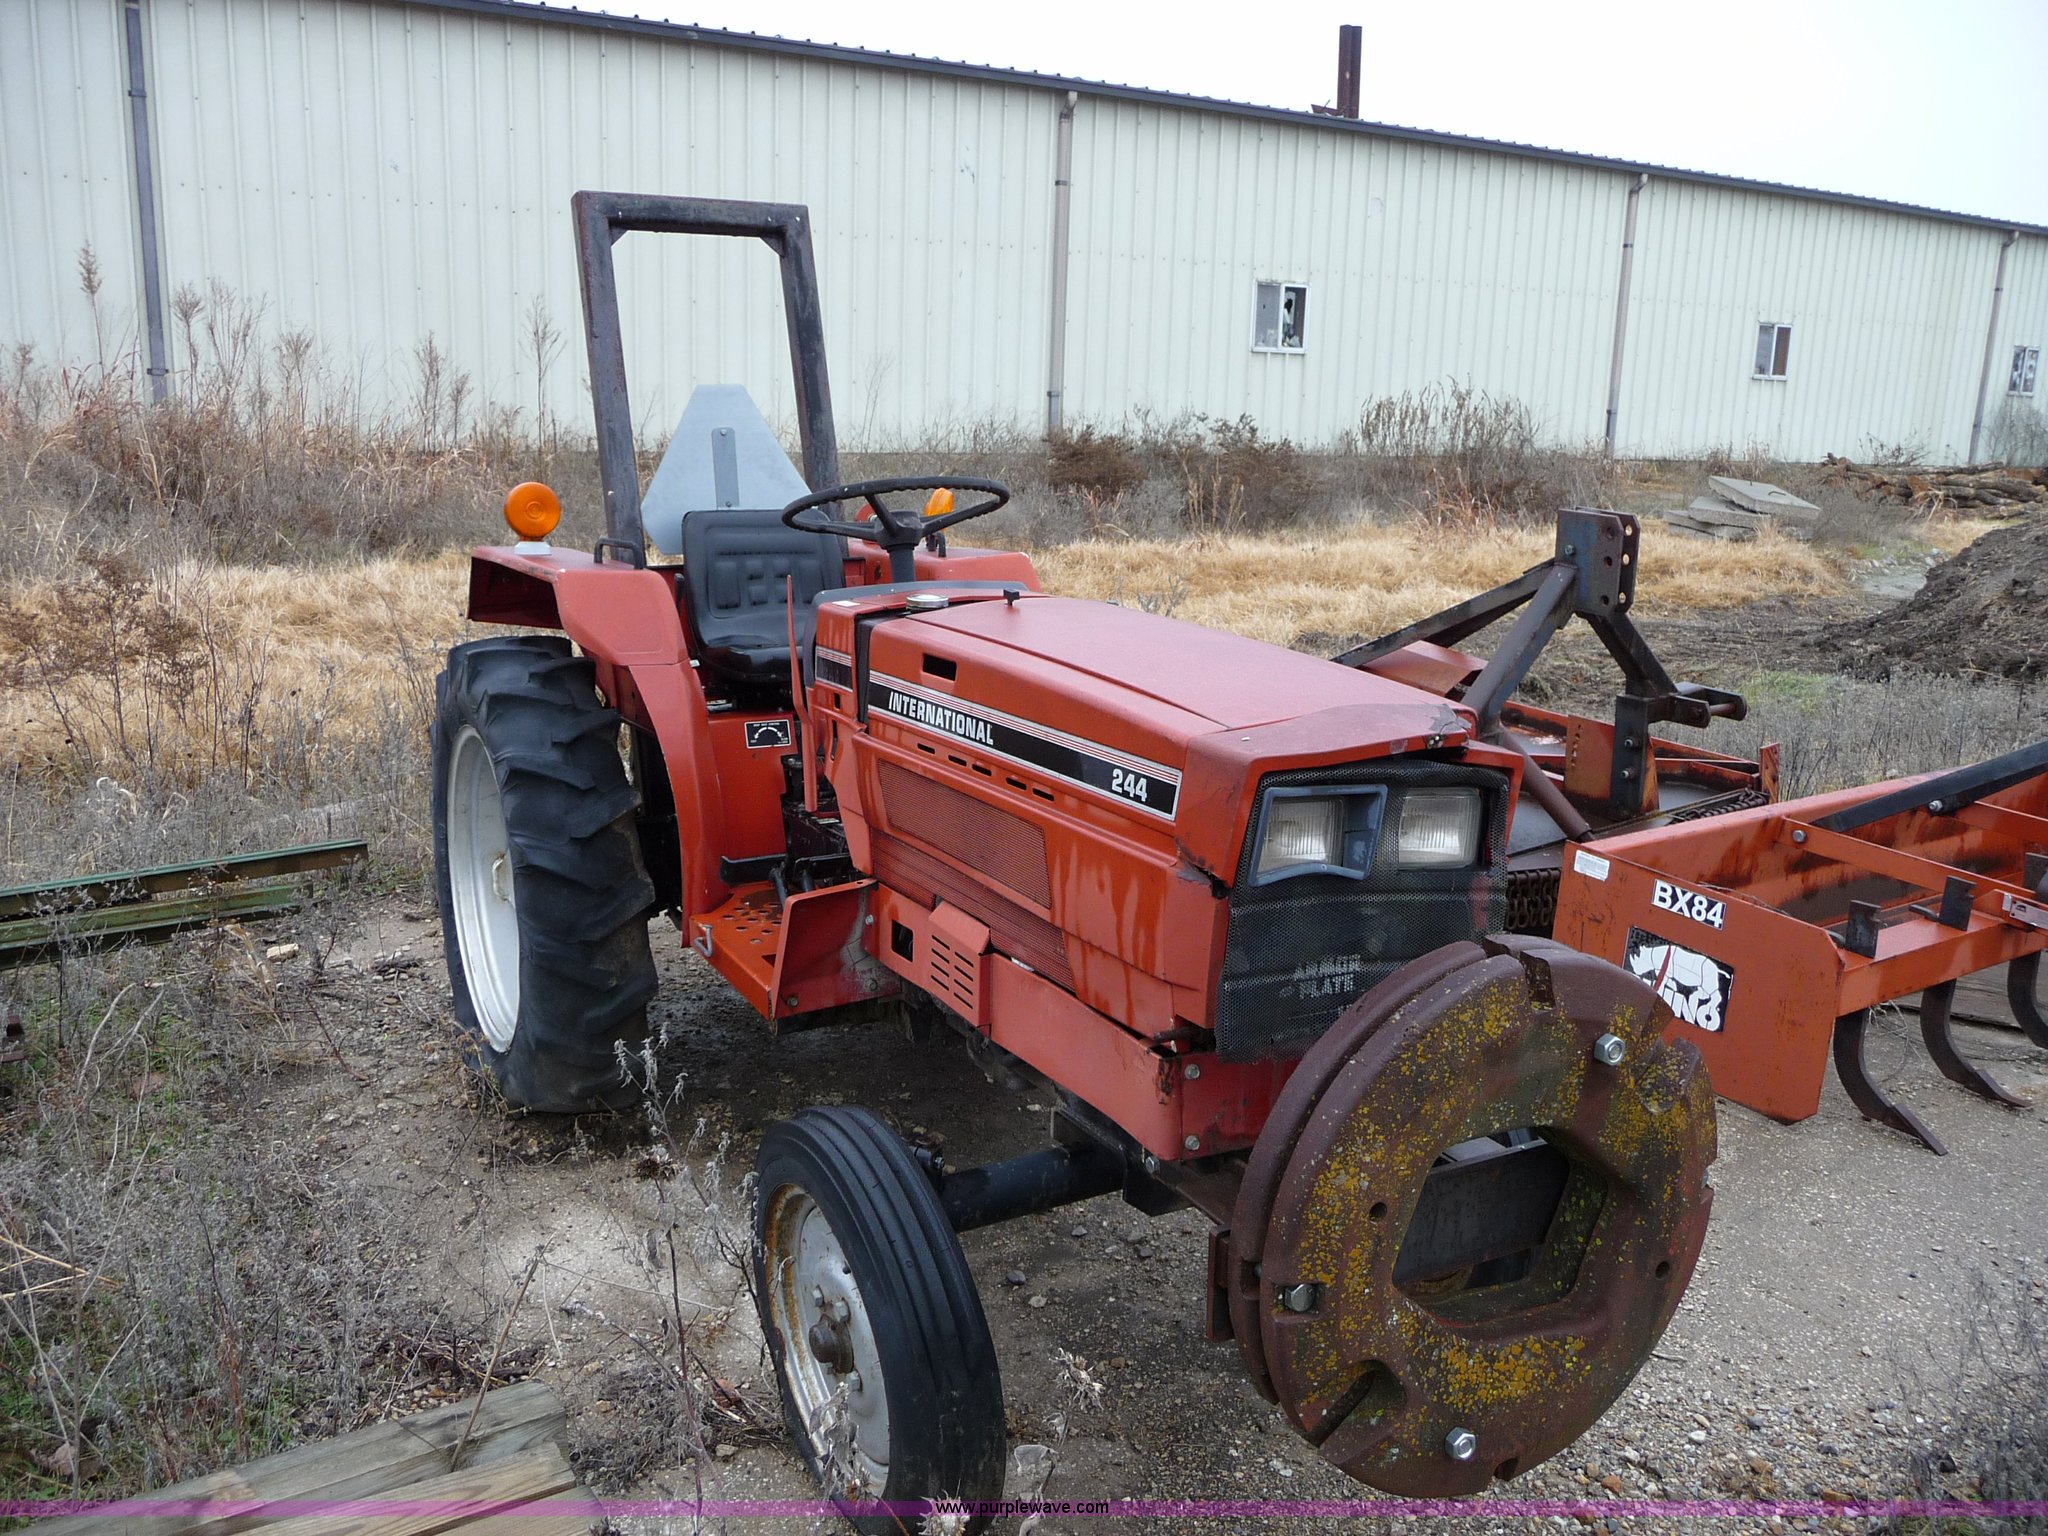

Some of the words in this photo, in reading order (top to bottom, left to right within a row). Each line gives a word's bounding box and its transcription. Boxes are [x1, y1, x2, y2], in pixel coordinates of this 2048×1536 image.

[888, 691, 994, 745] INTERNATIONAL
[1112, 768, 1148, 802] 244
[1653, 880, 1723, 928] BX84
